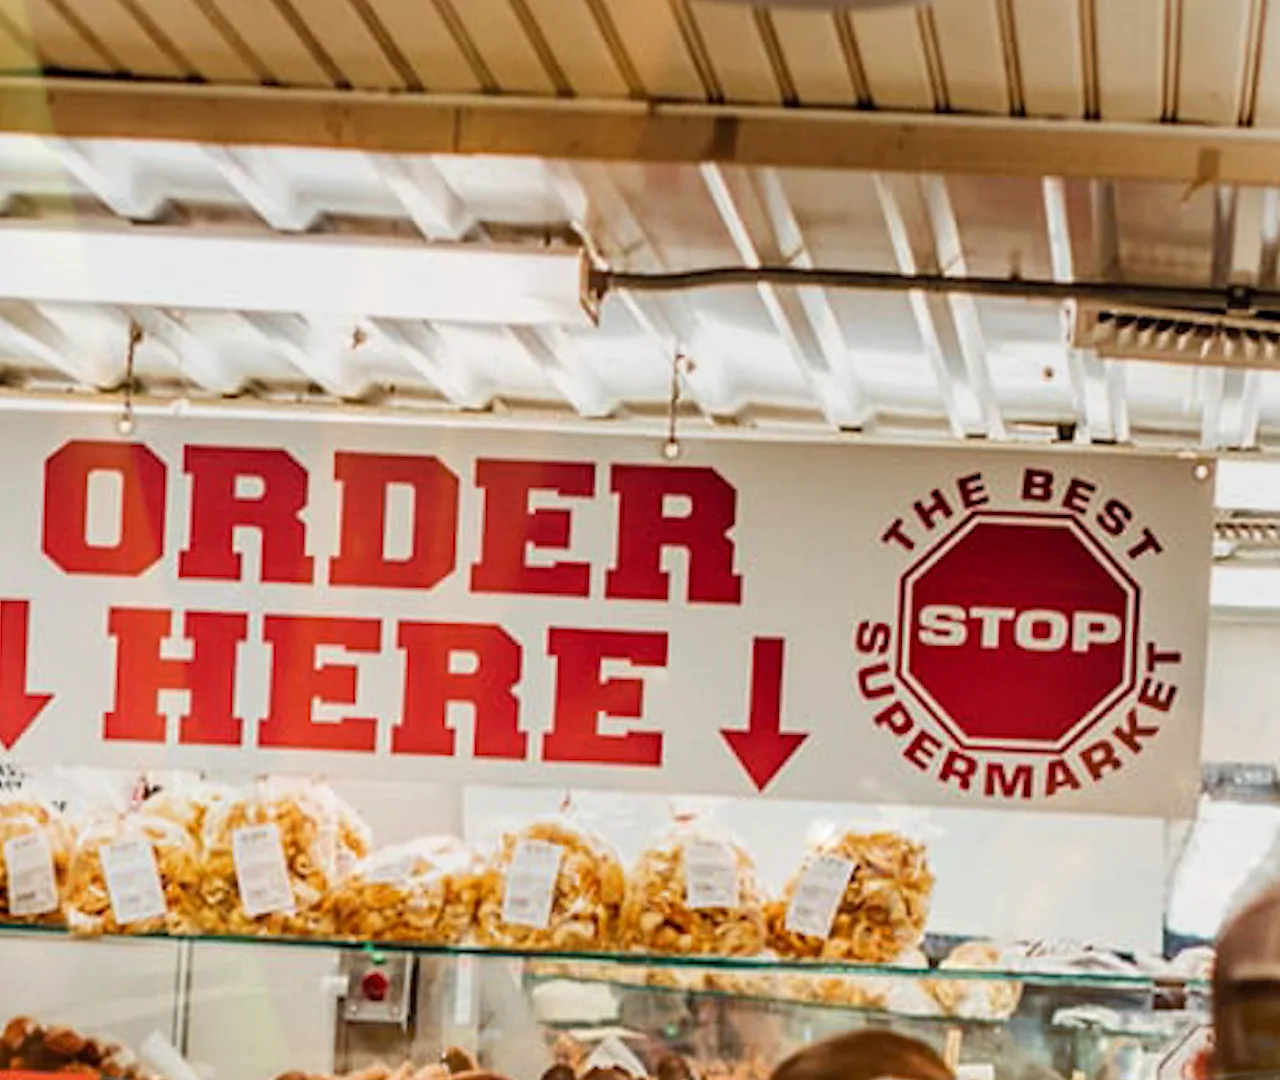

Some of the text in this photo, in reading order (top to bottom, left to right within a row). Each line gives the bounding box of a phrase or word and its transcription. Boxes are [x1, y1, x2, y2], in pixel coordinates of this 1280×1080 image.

[42, 439, 743, 605] ORDER
[881, 468, 1164, 561] THE BEST
[104, 606, 669, 768] HERE
[856, 620, 1182, 799] SUPERMARKET
[917, 604, 1121, 653] STOP
